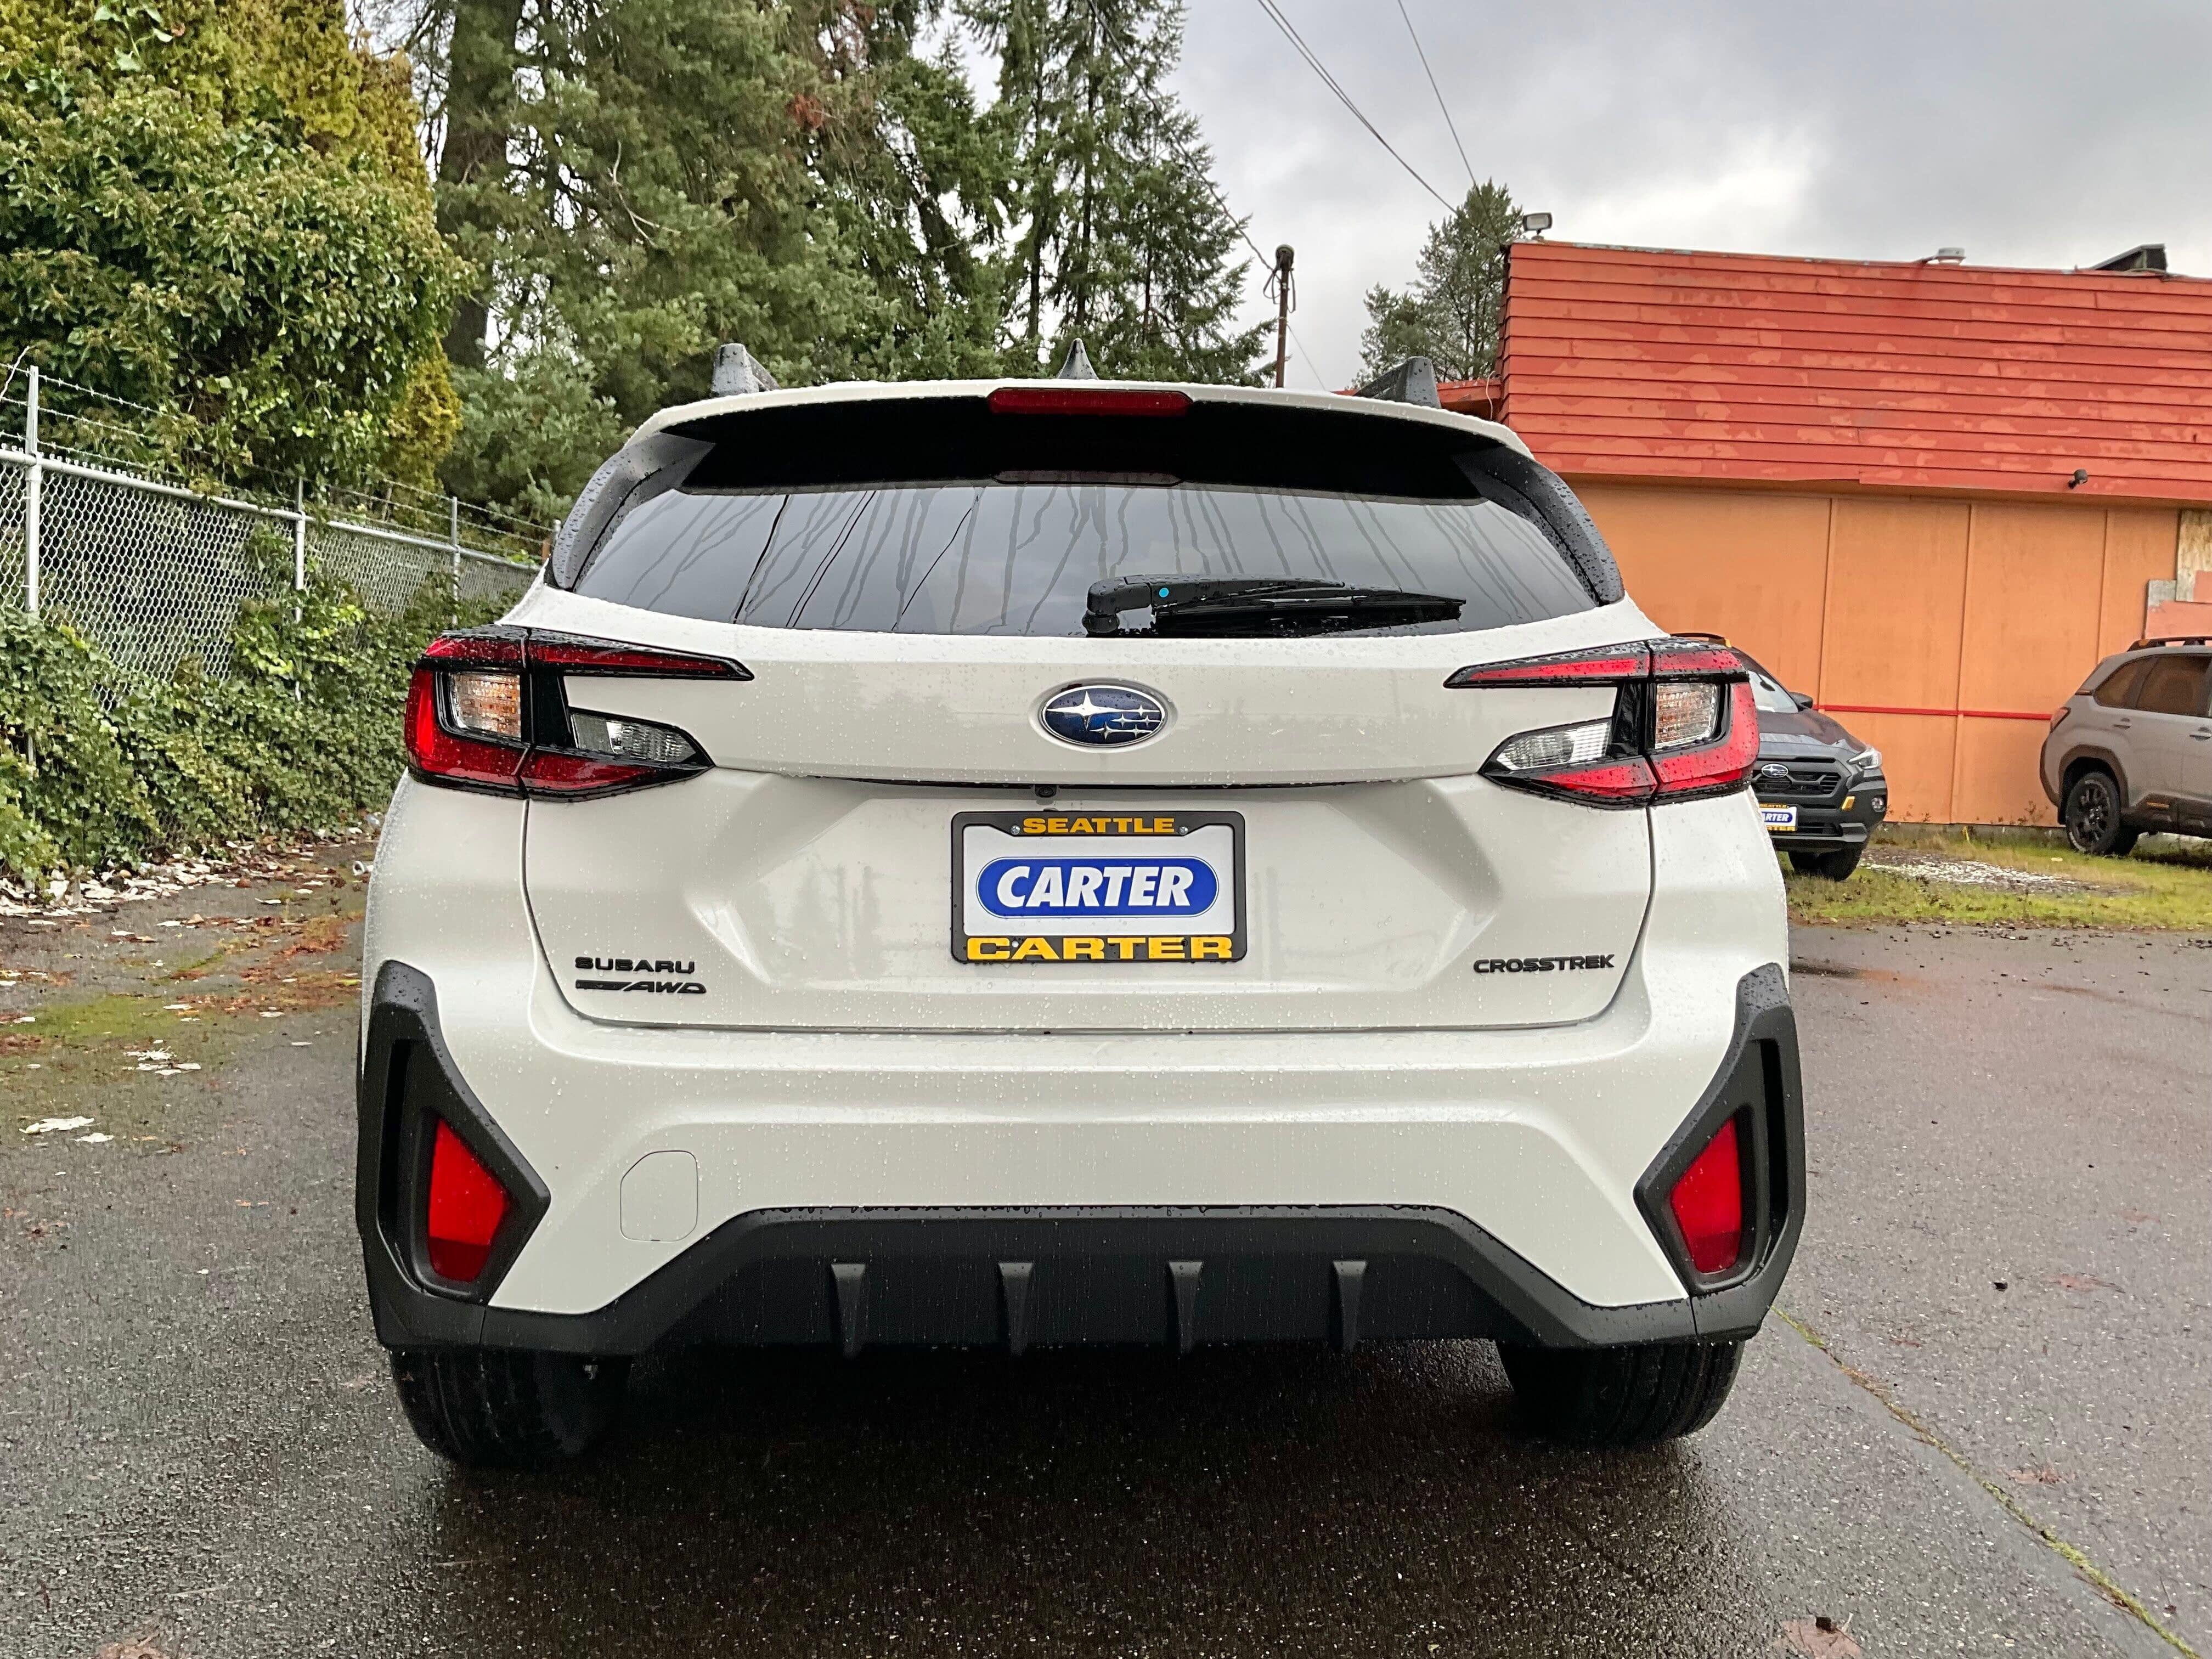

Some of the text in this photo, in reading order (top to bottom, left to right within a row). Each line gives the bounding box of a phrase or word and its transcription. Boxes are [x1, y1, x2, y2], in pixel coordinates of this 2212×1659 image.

[1023, 817, 1175, 833] SEATTLE
[996, 866, 1194, 907] CARTER
[967, 937, 1232, 960] CARTER
[575, 957, 695, 974] SUBARU
[1474, 954, 1615, 973] CROSSTREK
[623, 981, 707, 994] AWD
